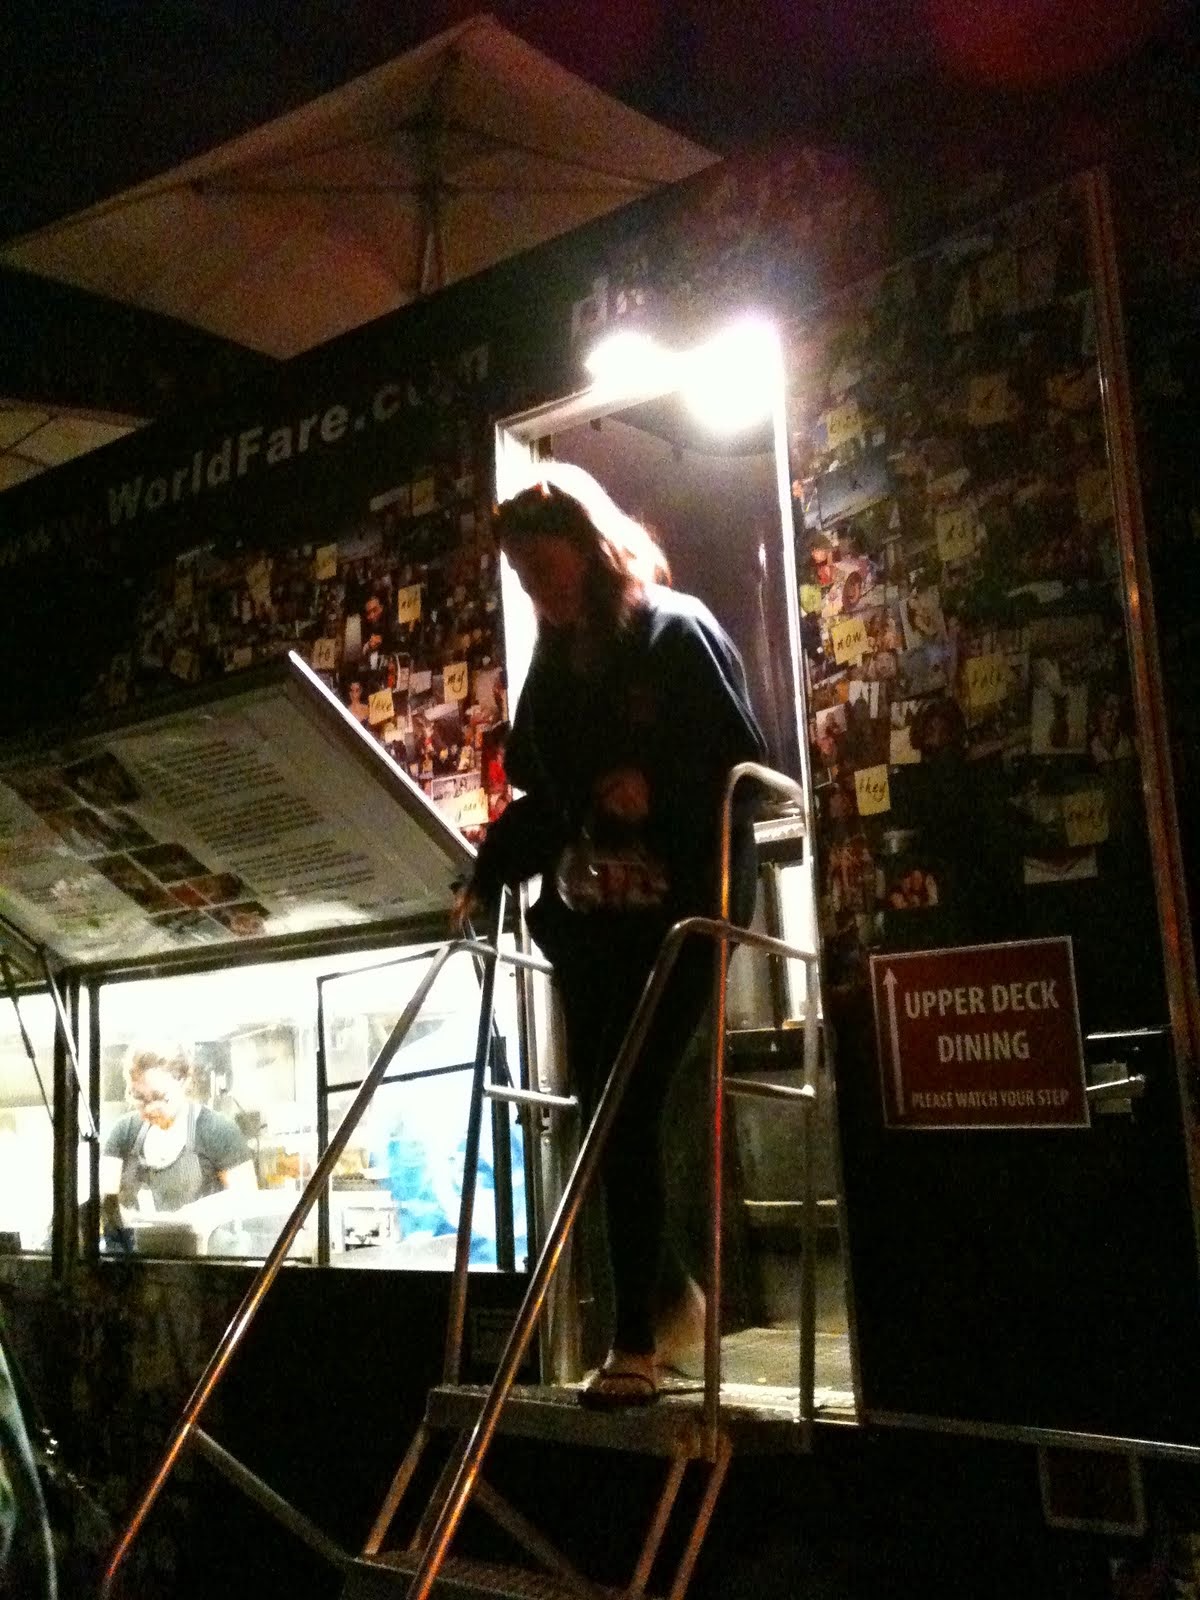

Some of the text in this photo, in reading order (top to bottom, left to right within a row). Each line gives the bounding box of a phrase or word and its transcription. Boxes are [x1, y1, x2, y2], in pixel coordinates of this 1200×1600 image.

[905, 979, 1060, 1019] UPPER DECK
[937, 1029, 1031, 1063] DINING
[911, 1086, 1070, 1109] PLEASE WATCH YOUR STEP
